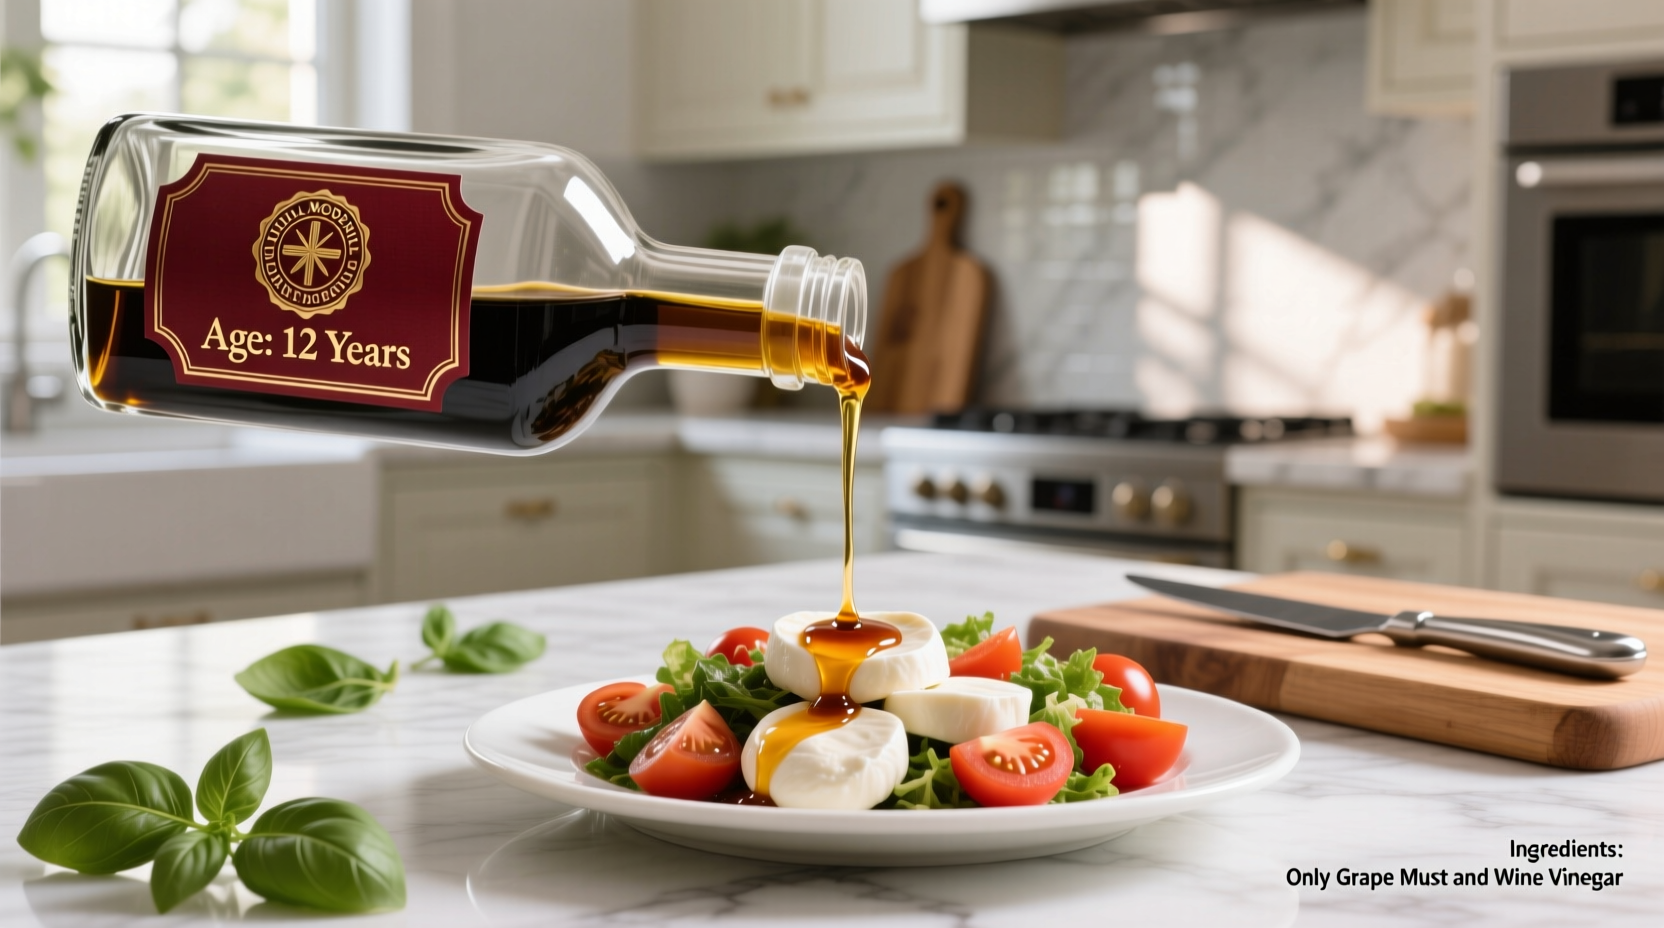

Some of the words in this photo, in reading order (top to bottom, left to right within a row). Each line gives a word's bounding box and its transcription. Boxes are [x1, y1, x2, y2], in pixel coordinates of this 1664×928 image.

[201, 317, 273, 363] Age:
[282, 326, 318, 361] 12
[325, 329, 411, 370] Years
